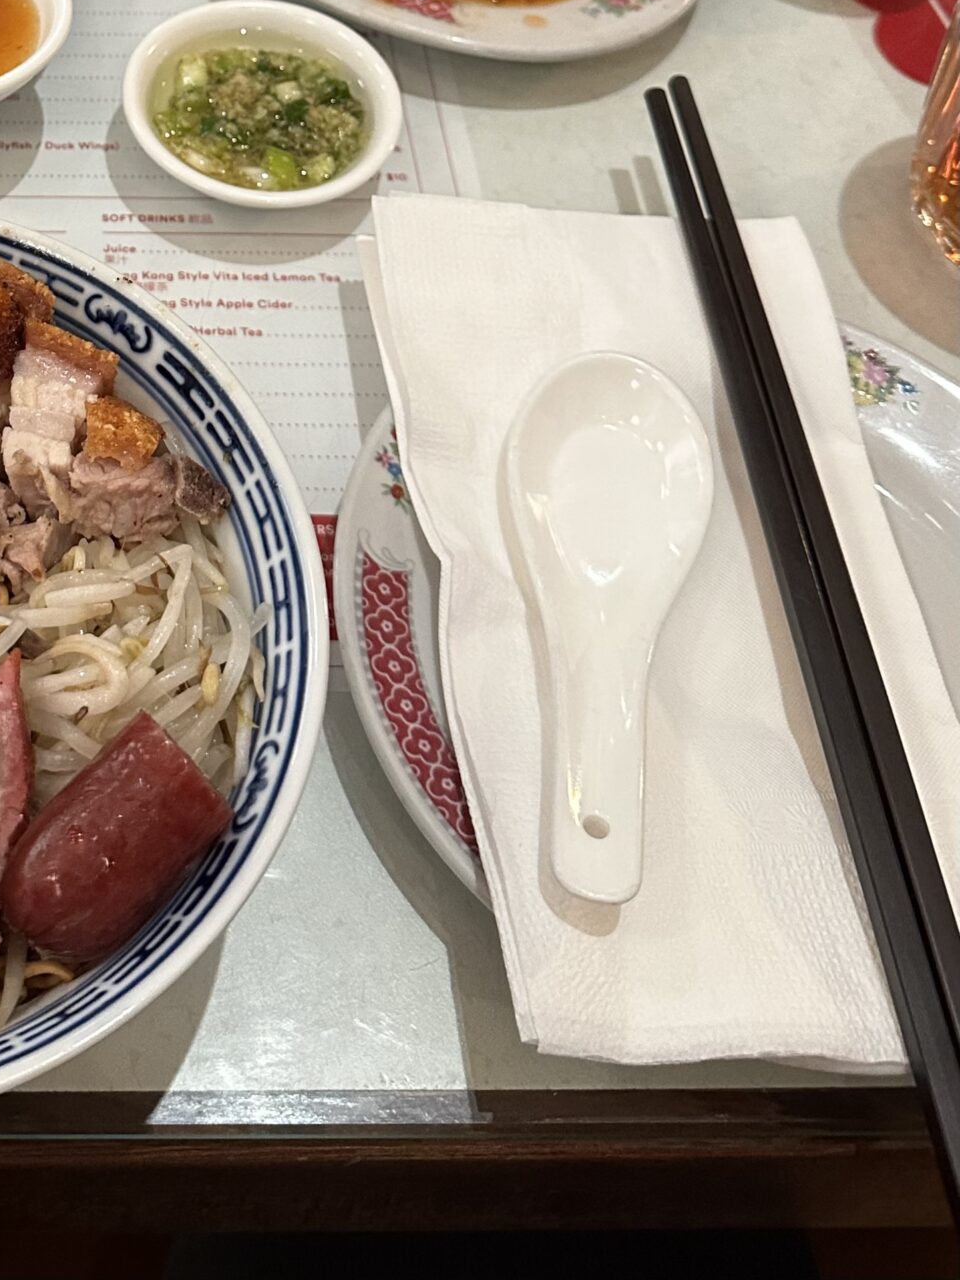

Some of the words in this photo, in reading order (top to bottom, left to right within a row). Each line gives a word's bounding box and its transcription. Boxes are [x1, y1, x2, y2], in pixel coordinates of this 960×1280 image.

[44, 141, 74, 150] Duck
[78, 141, 120, 152] Wings)
[102, 213, 133, 223] SOFT
[139, 214, 185, 223] DRINKS
[103, 244, 136, 253] Juice
[142, 271, 174, 282] Kong
[178, 271, 209, 282] Style
[213, 272, 238, 281] Vita
[242, 271, 269, 281] Iced
[273, 272, 316, 282] Lemon
[319, 272, 340, 282] Tea
[180, 297, 212, 310] Style
[216, 297, 254, 310] Apple
[257, 299, 293, 309] Cider
[241, 326, 263, 336] Tea
